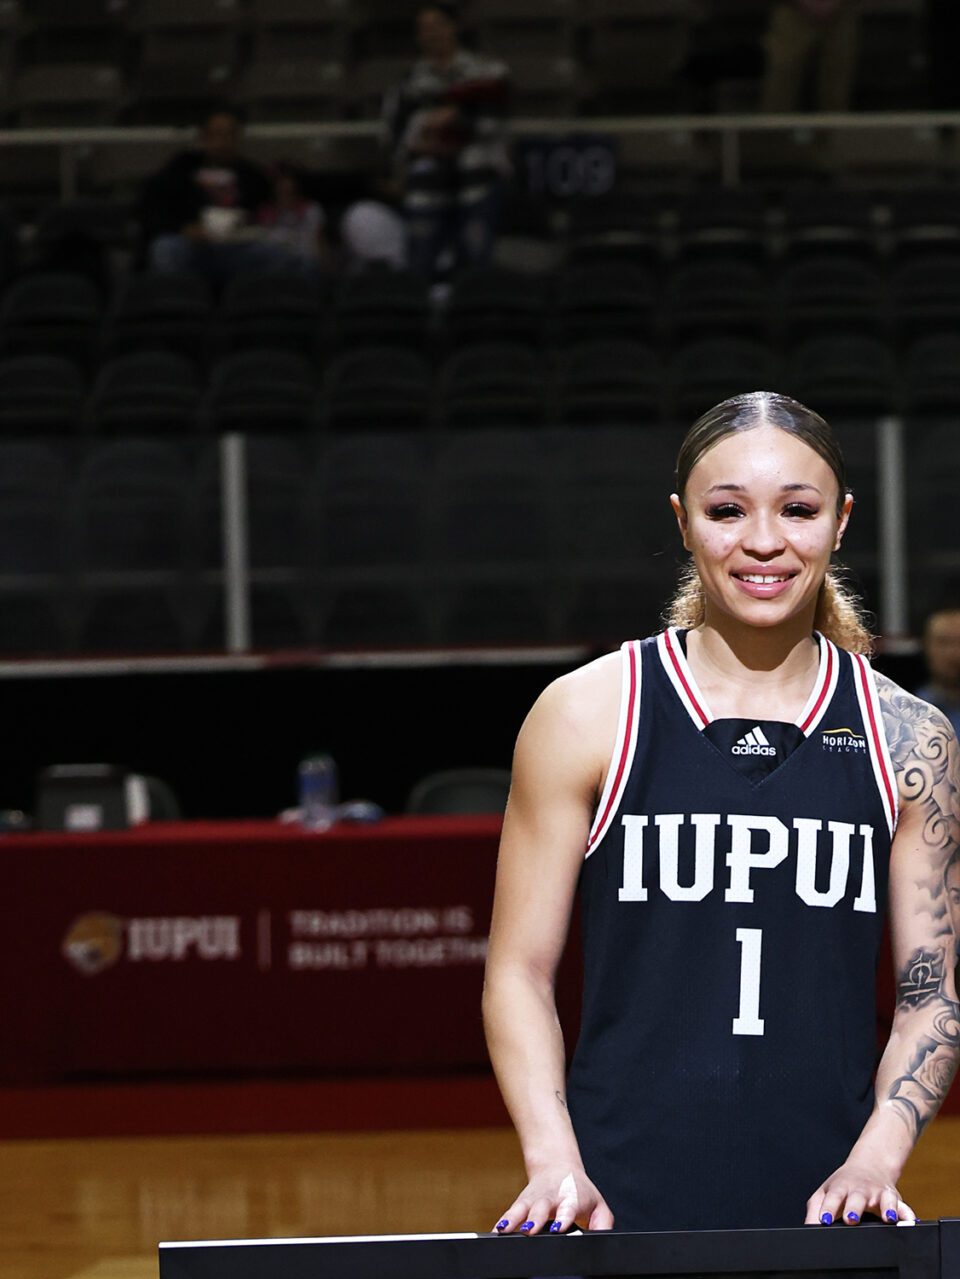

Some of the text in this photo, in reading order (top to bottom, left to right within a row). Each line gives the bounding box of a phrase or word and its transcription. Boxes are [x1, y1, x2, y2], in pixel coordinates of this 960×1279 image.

[731, 744, 777, 756] adidas
[822, 735, 866, 748] HORIZON
[618, 813, 877, 913] IUPUI
[290, 905, 473, 936] TRADITION IS
[128, 915, 240, 961] IUPUI
[288, 941, 368, 970] BUILT
[732, 928, 765, 1036] 1
